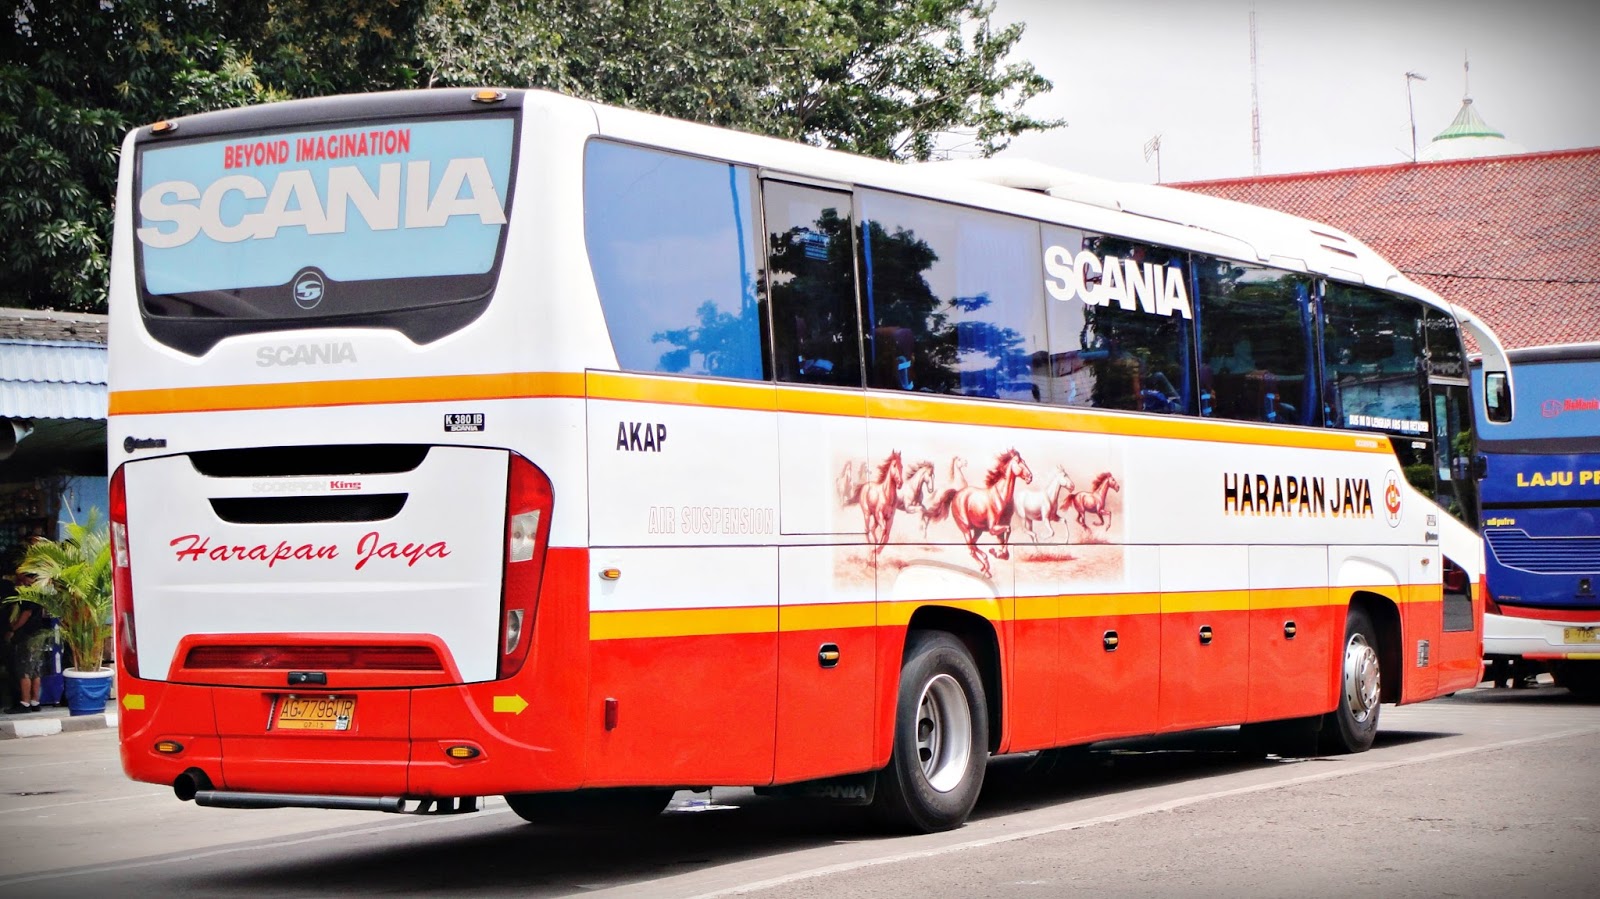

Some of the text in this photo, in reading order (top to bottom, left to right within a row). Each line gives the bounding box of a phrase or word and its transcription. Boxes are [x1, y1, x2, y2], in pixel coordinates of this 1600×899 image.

[224, 129, 411, 169] BEYOND IMAGINATION
[137, 157, 507, 249] SCANIA
[1044, 245, 1193, 319] SCANIA
[256, 342, 358, 367] SCANIA
[446, 414, 483, 425] K 380 IB
[616, 421, 667, 453] AKAP
[1516, 471, 1573, 487] LAJU
[1224, 473, 1375, 519] HARAPAN JAYA
[648, 506, 773, 535] AIR SUSPENSION
[170, 531, 452, 571] Harapan Jaya
[281, 699, 298, 717] AG
[300, 699, 335, 718] 7796
